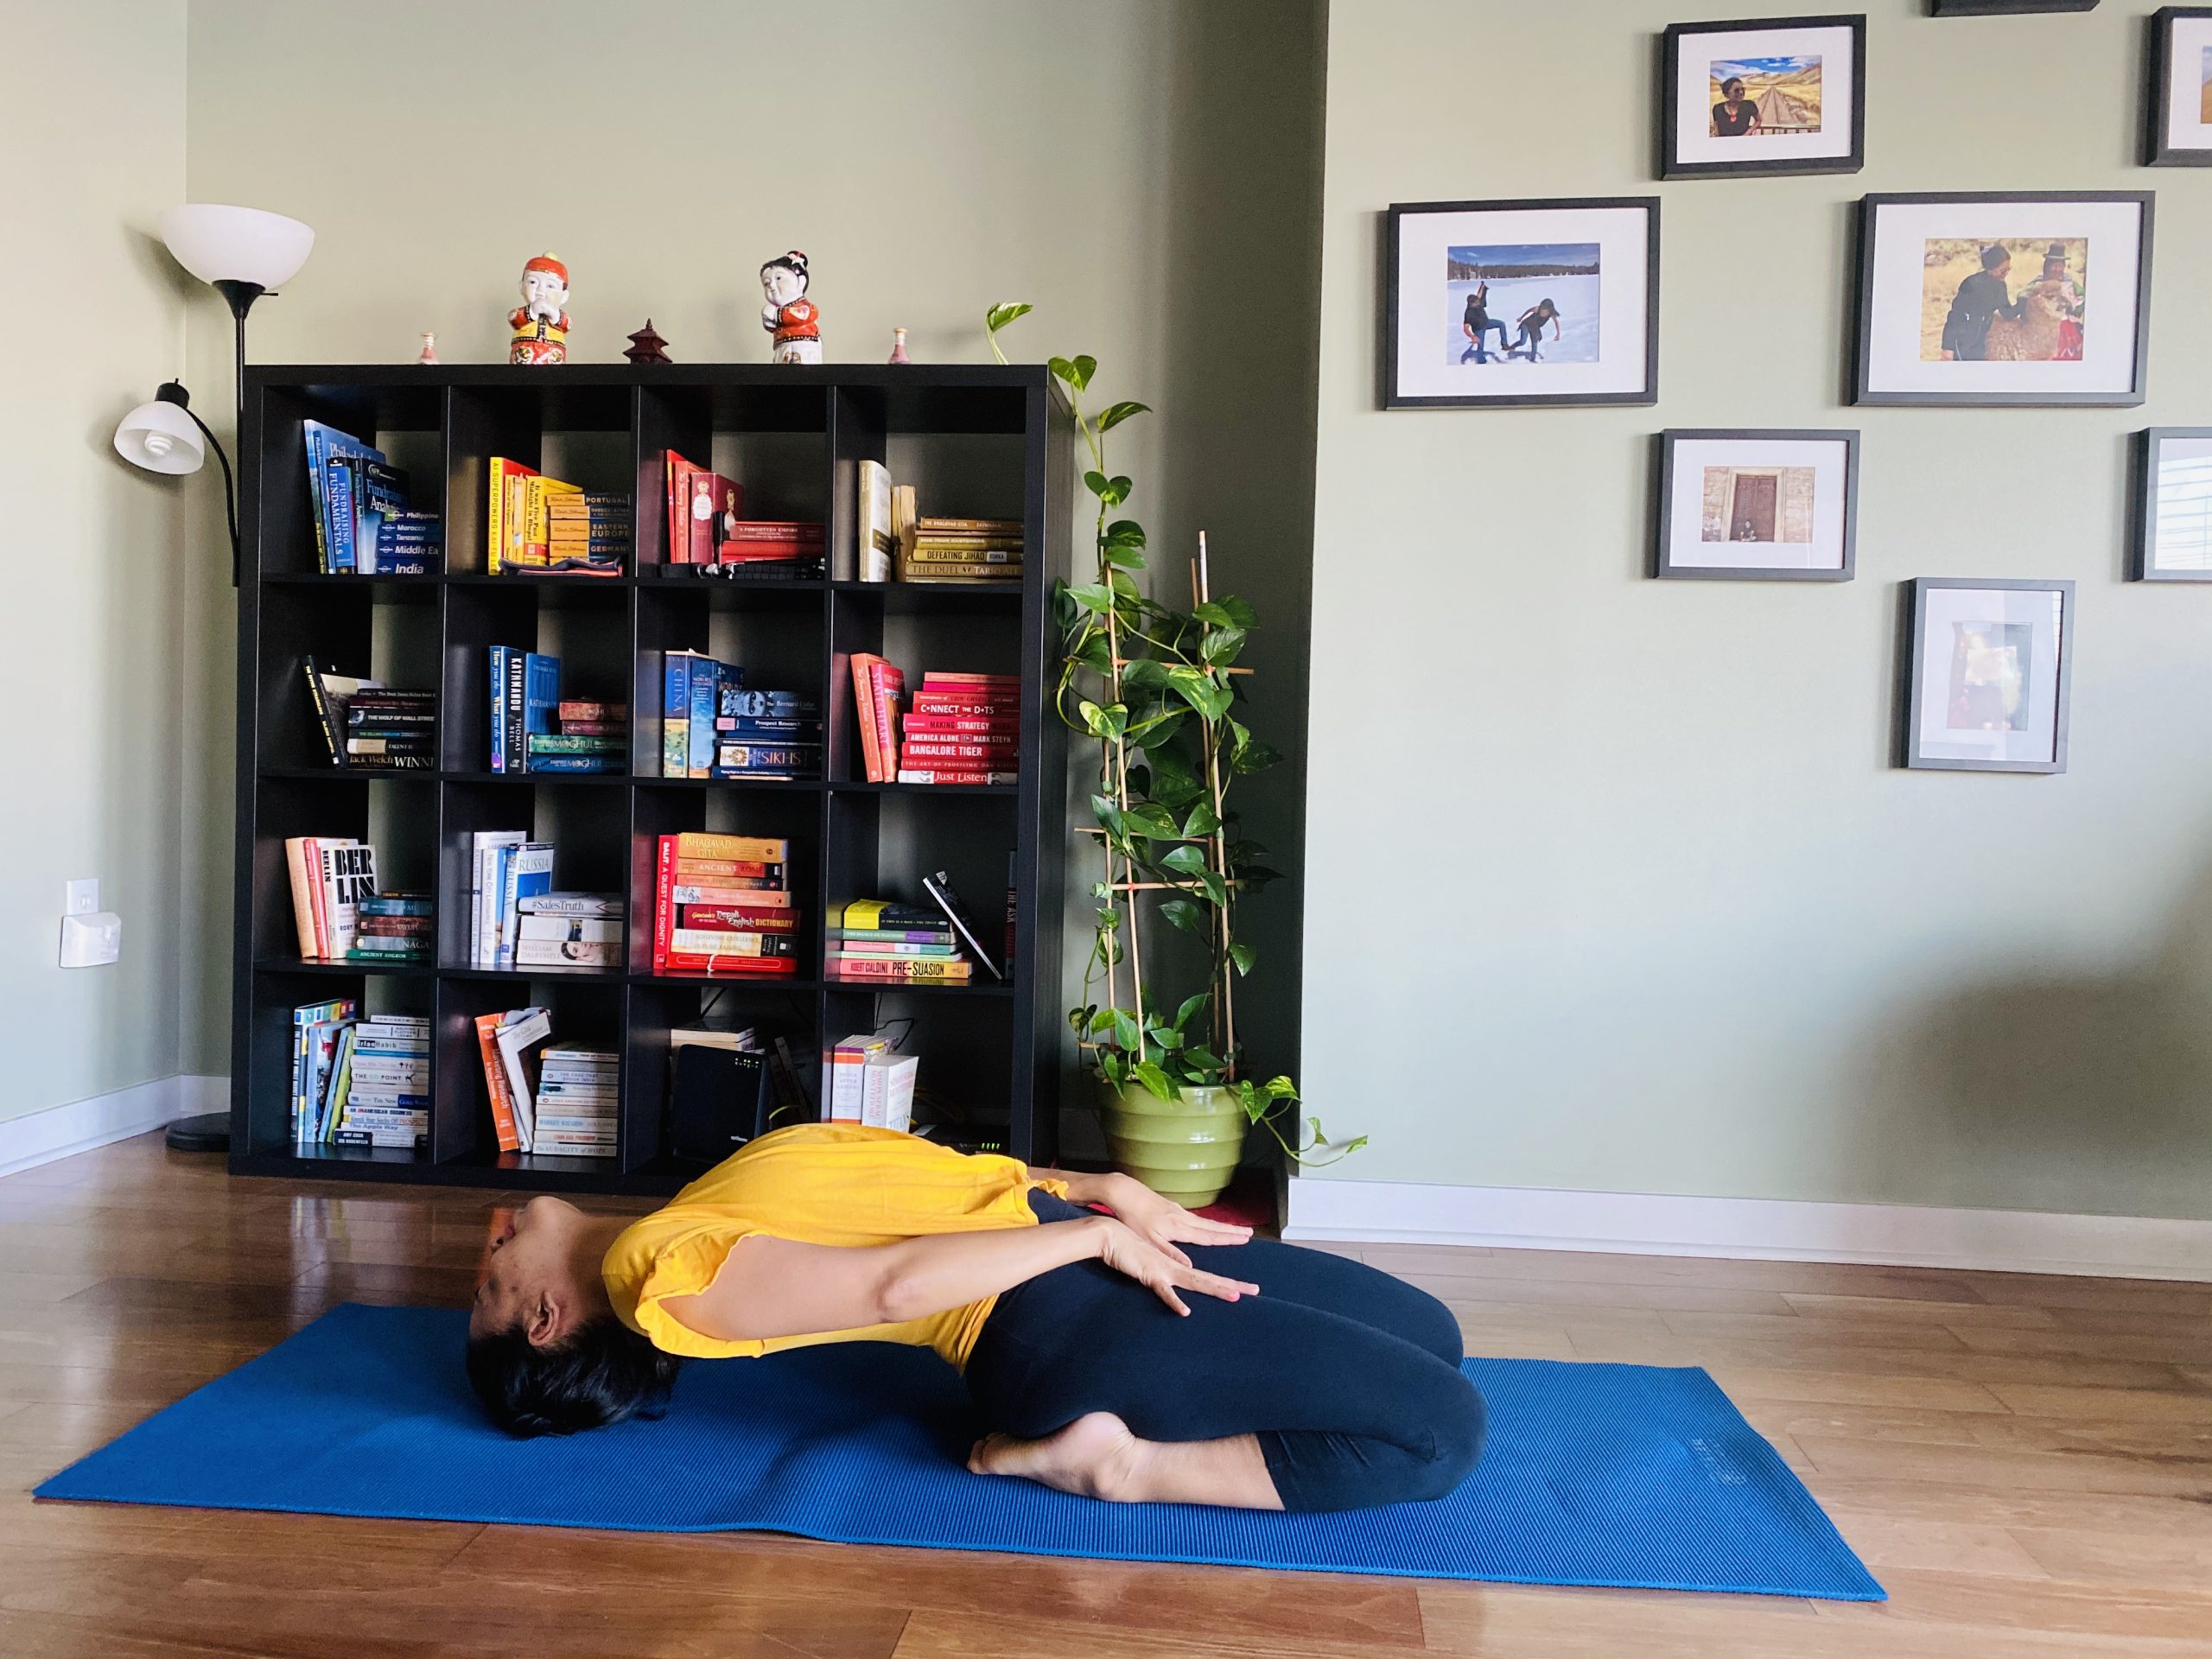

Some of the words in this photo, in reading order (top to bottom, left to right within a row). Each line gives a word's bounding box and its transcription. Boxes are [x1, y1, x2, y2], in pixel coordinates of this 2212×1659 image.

[490, 473, 499, 530] SUPERPOWERS
[329, 473, 343, 555] FUNDAMENTALS
[340, 482, 350, 544] FUNDRAISING
[525, 518, 534, 541] Bhopal
[395, 545, 426, 554] Middle
[428, 546, 439, 555] Ea
[927, 550, 963, 560] DEFEATING
[964, 551, 985, 561] JIHAD
[395, 563, 424, 574] India
[912, 565, 933, 574] THE
[510, 658, 522, 711] KATHMANDU
[673, 668, 684, 712] CHINA
[876, 710, 888, 744] HEART
[930, 721, 956, 729] MAKING
[957, 721, 989, 730] STRATEGY
[554, 739, 595, 750] MOGHUL
[909, 746, 957, 756] BANGALORE
[958, 747, 982, 756] TIGER
[350, 754, 366, 764] Jack
[369, 754, 393, 764] Welch
[394, 756, 435, 767] WINNI
[568, 758, 603, 768] MOGHUL
[761, 752, 801, 766] SIKHS
[934, 771, 955, 782] Just
[957, 772, 988, 783] Listen
[685, 836, 733, 849] BHAGAVAD
[697, 849, 719, 858] GITA
[322, 849, 332, 882] BERLIN
[334, 849, 373, 876] BER
[518, 858, 550, 872] RUSSIA
[336, 876, 376, 904] LIN
[505, 871, 515, 906] RUSSIA
[1007, 890, 1016, 905] THE
[532, 900, 584, 912] #SalesTruth
[728, 916, 755, 929] English
[755, 918, 794, 928] DICTIONARY
[1006, 907, 1016, 924] ASK
[402, 940, 429, 949] NAGA
[865, 963, 888, 974] CIALDINI
[893, 962, 944, 976] PRE-SUASION
[492, 1048, 503, 1080] Marketing
[498, 1079, 510, 1109] Research
